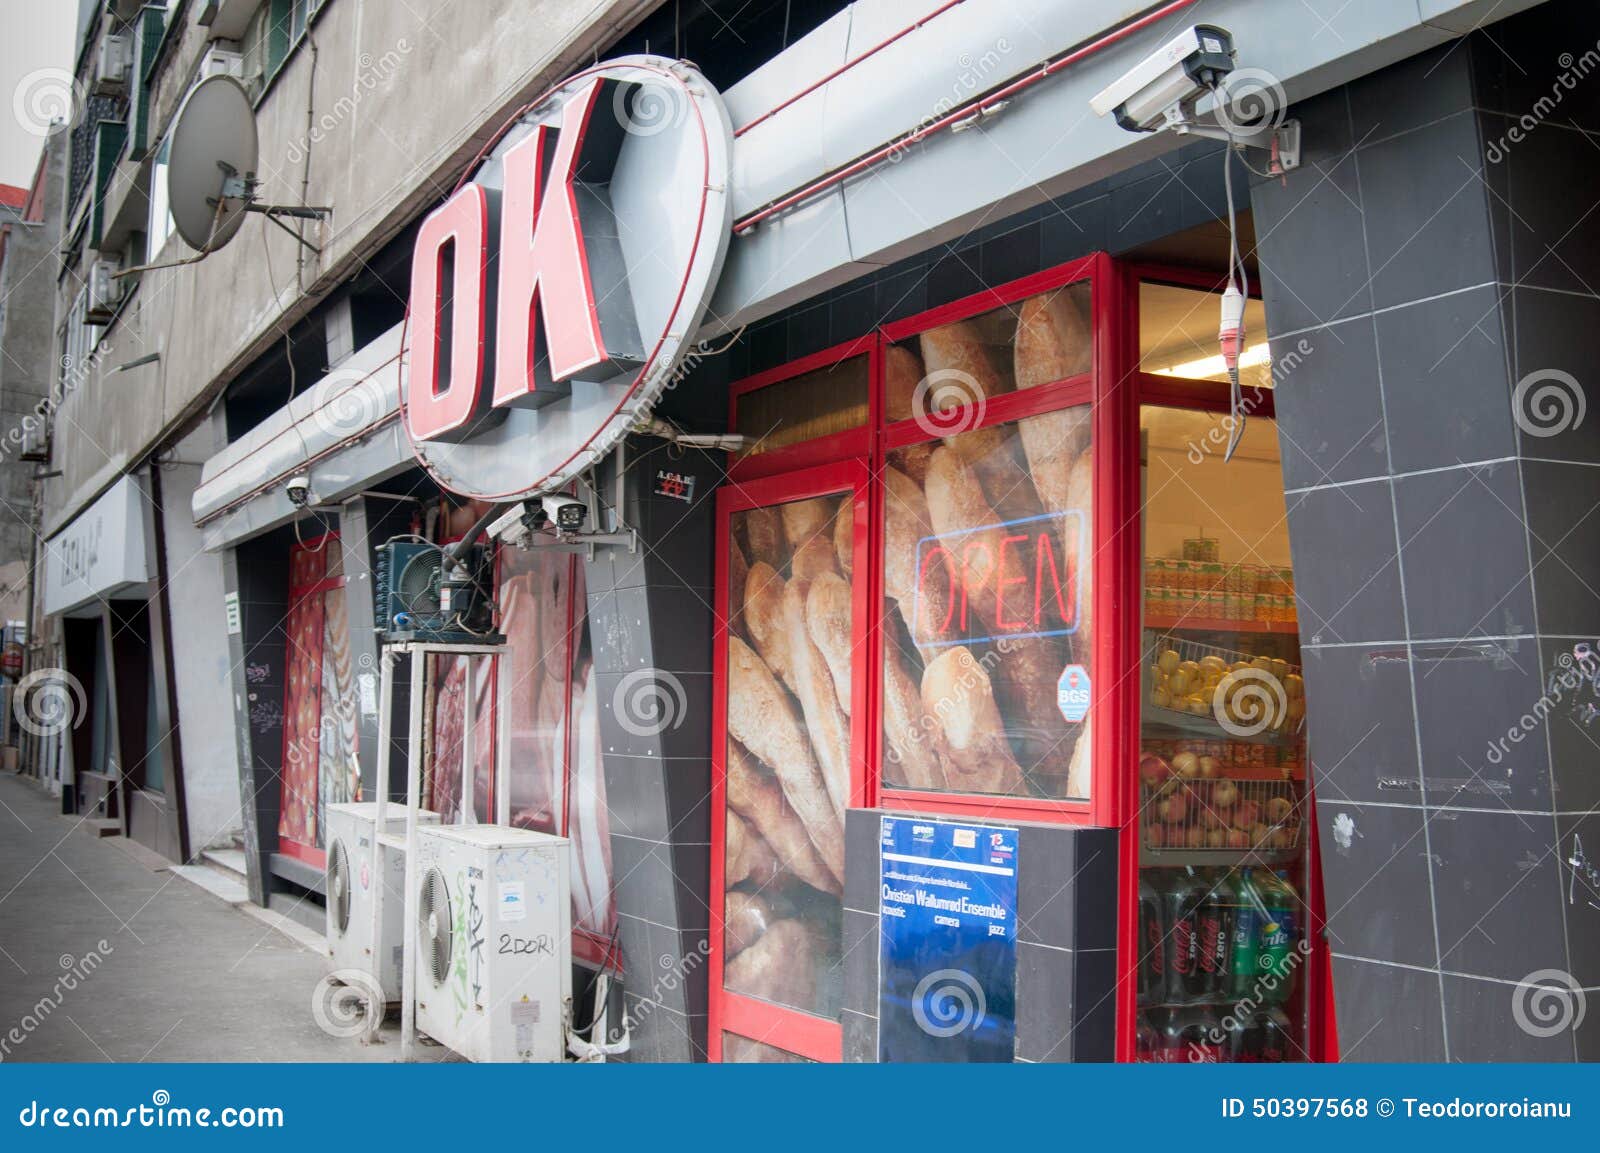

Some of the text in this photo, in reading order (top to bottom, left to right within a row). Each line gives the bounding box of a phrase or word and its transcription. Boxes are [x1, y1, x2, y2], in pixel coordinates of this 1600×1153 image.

[407, 76, 608, 441] OK
[918, 527, 1076, 633] OPEN
[882, 883, 915, 905] Christian
[961, 896, 1006, 920] Ensemble
[934, 915, 960, 928] camera
[988, 922, 1006, 936] jazz
